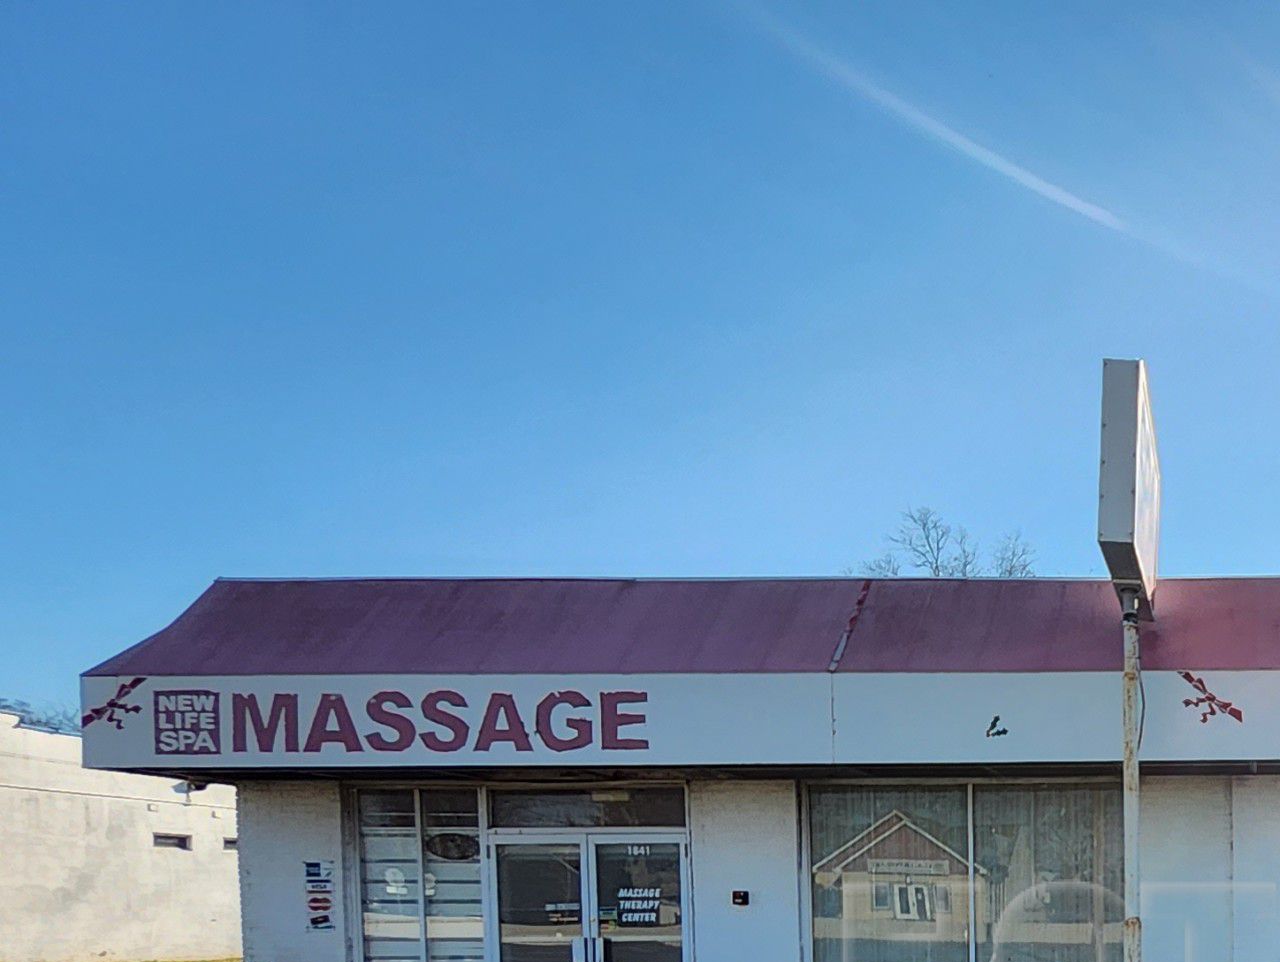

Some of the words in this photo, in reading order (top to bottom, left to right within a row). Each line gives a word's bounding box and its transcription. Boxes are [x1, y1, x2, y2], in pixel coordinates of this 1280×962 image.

[158, 694, 216, 712] NEW
[158, 712, 216, 729] LIFE
[232, 690, 649, 753] MASSAGE
[158, 730, 217, 752] SPA
[627, 845, 650, 856] 1841
[617, 887, 662, 898] MASSAGE
[619, 899, 660, 910] THERAPY
[621, 911, 657, 923] CENTER
